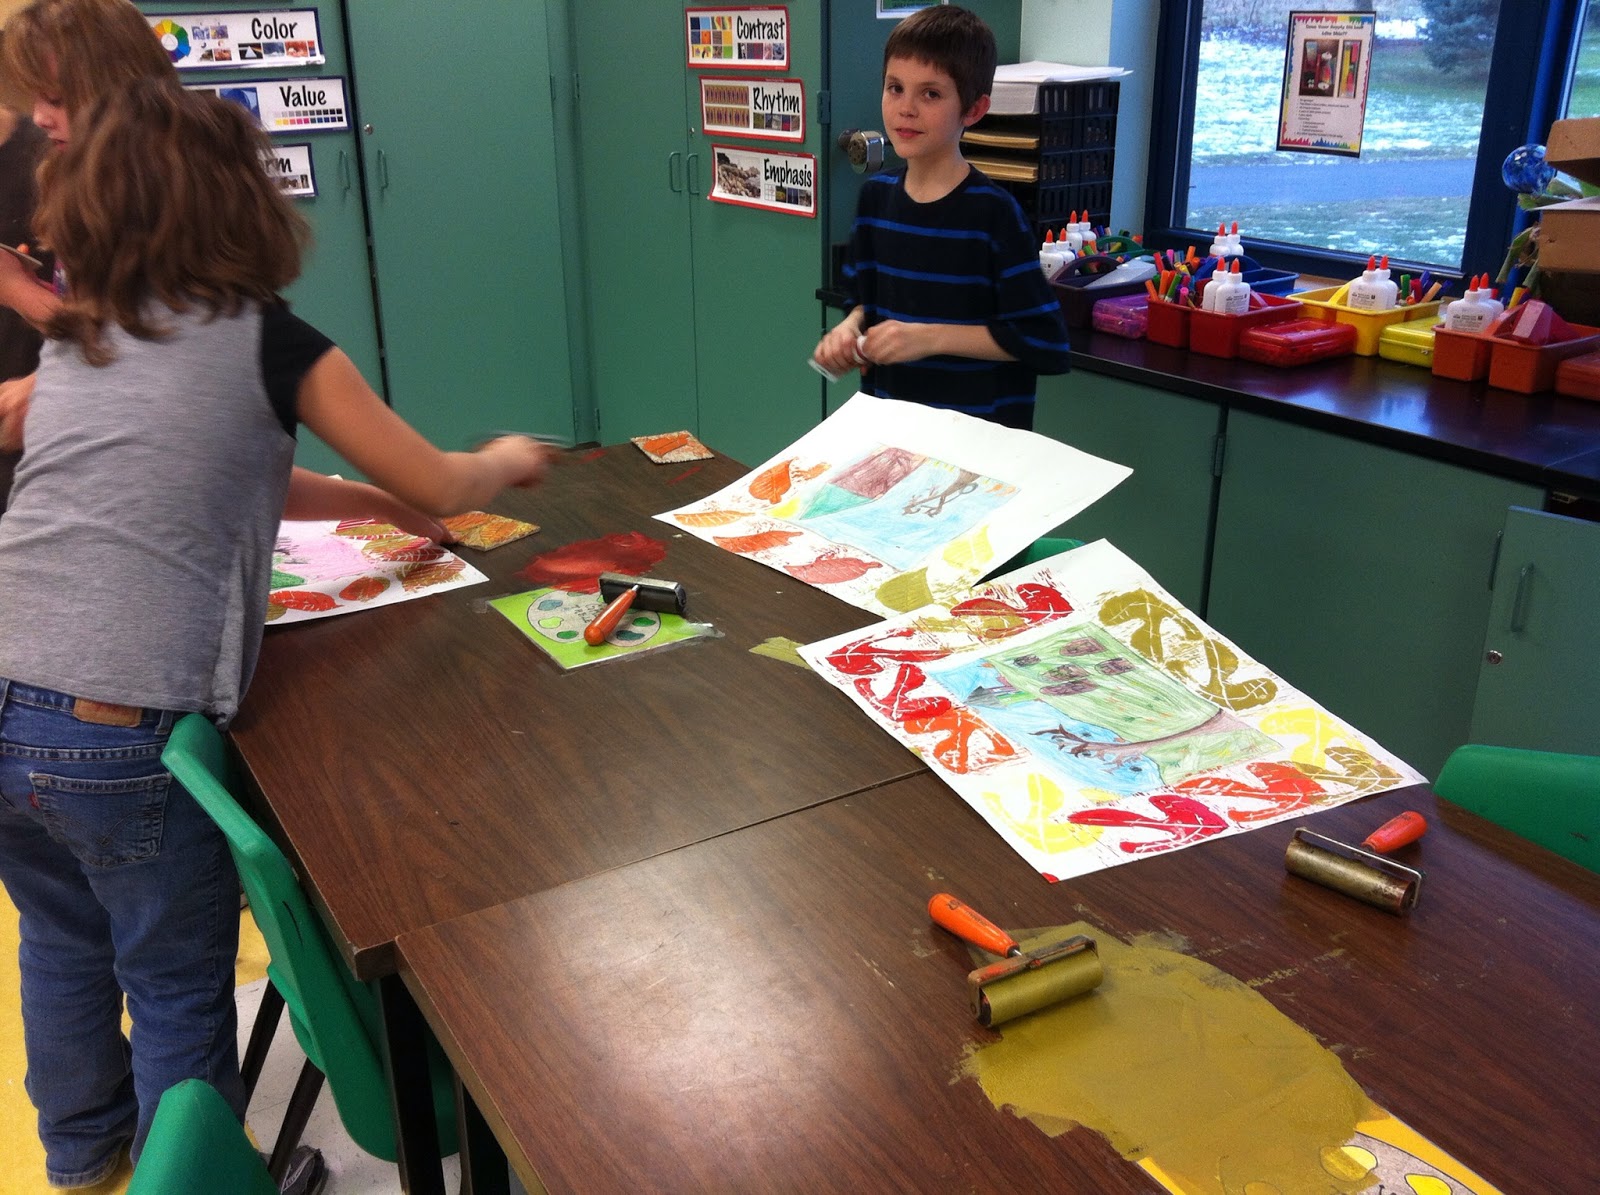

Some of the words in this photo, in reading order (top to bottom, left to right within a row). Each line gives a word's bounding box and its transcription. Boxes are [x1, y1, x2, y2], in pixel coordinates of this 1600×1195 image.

[251, 17, 298, 39] Color
[736, 15, 785, 40] Contrast
[279, 85, 327, 107] Value
[752, 86, 800, 116] Rhythm
[763, 158, 812, 189] Emphasis
